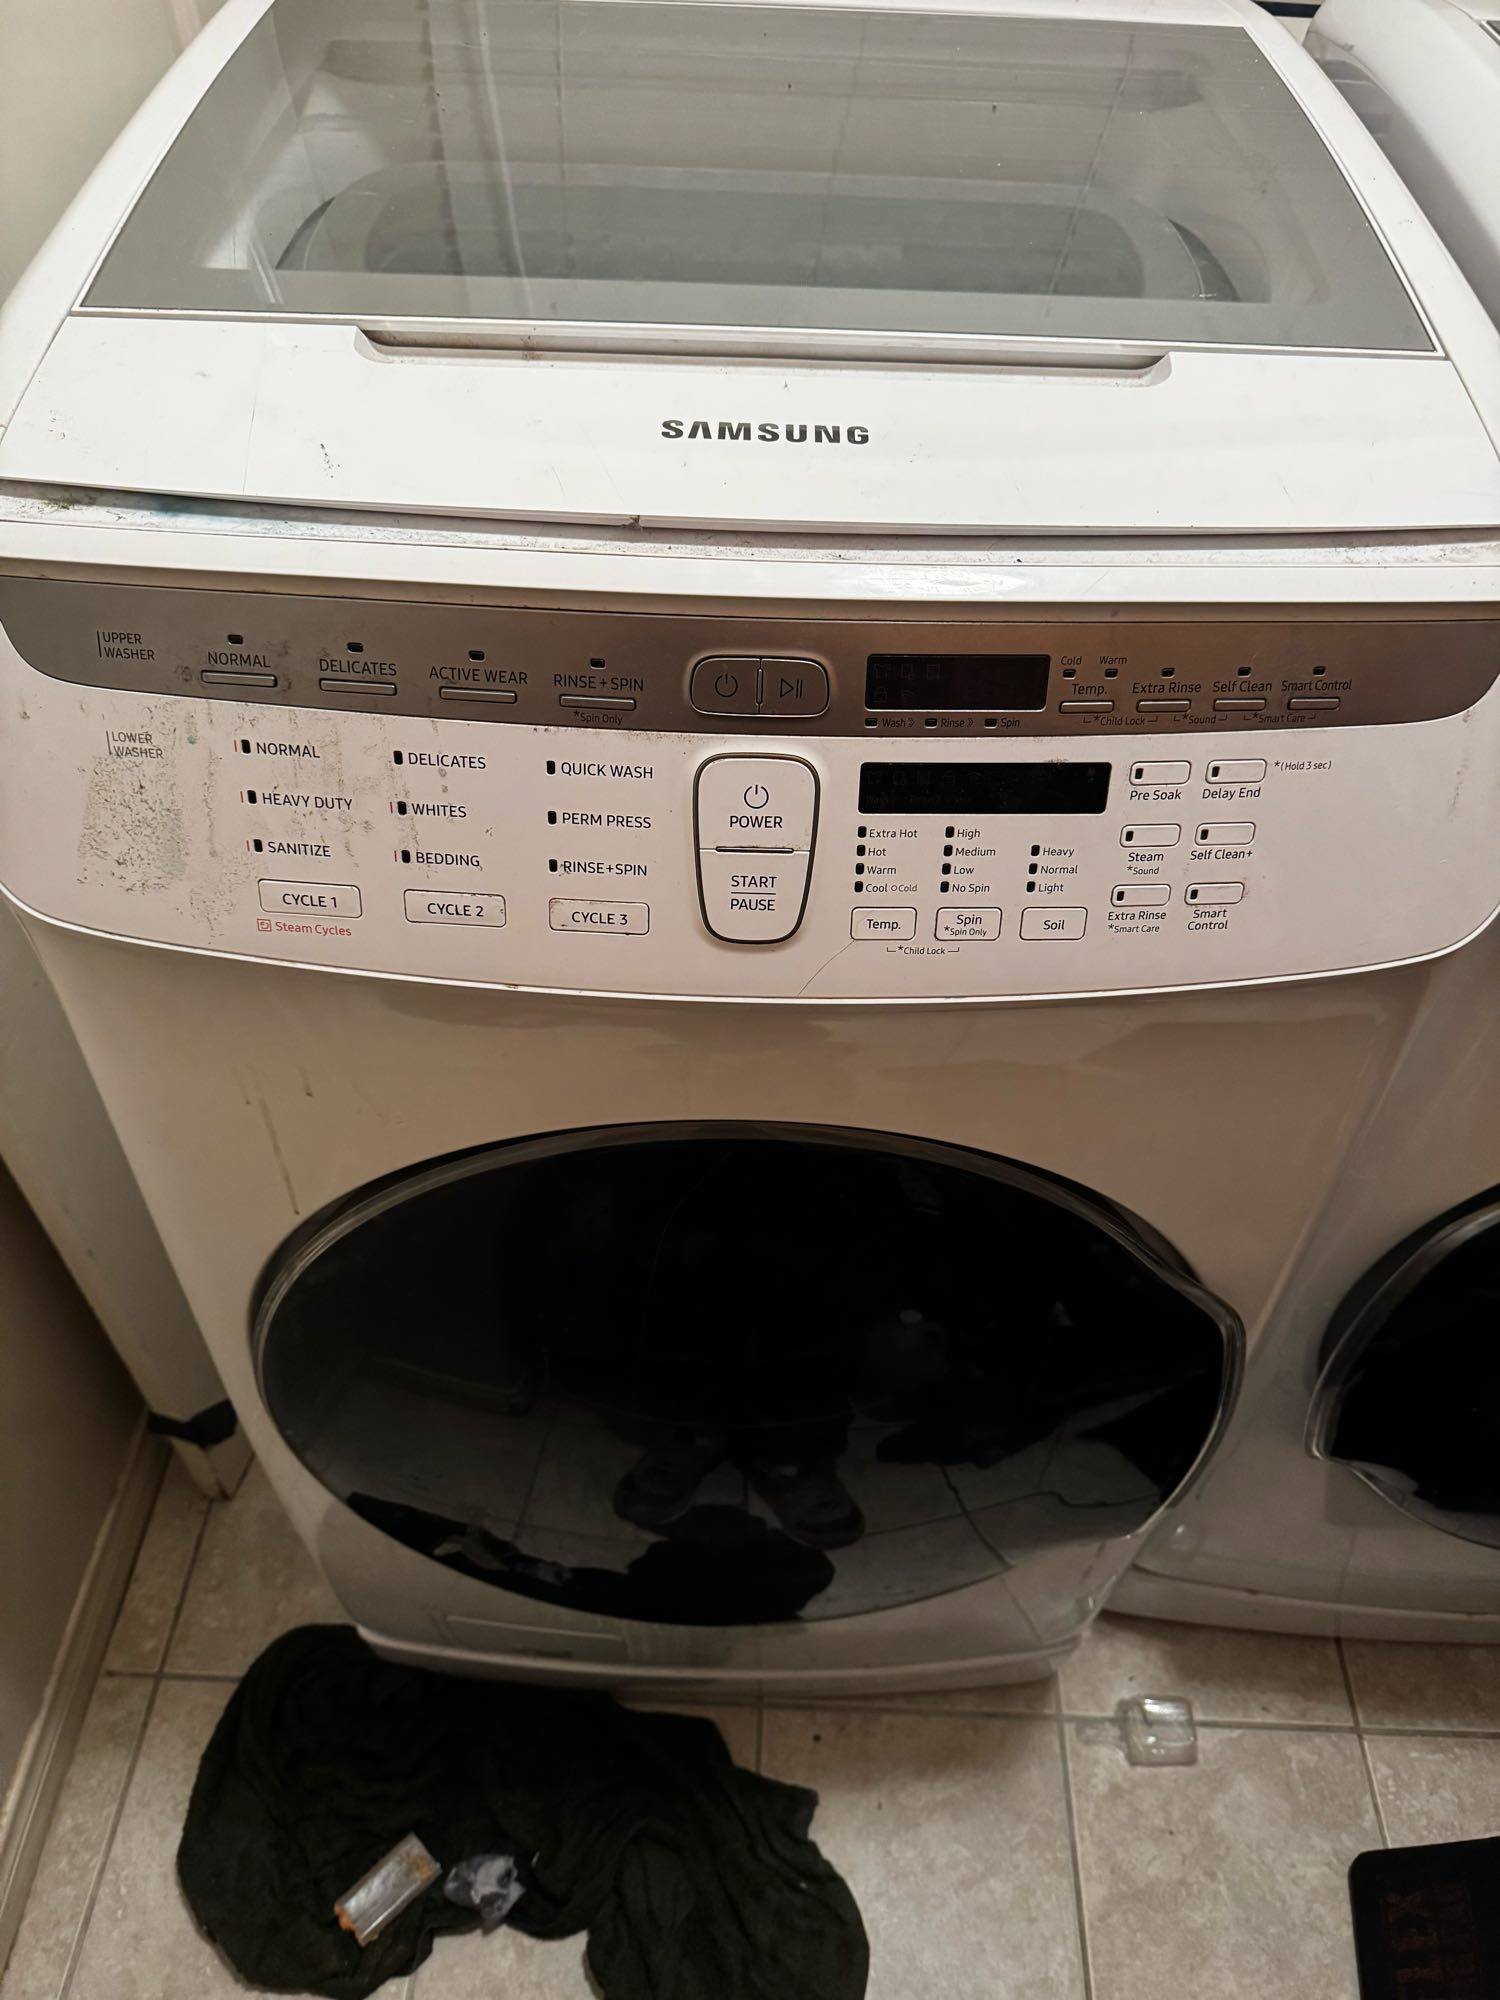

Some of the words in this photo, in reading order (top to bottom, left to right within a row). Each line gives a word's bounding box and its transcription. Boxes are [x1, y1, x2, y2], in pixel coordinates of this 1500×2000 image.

[661, 420, 870, 445] SAMSUNG
[102, 631, 142, 645] UPPER
[104, 647, 155, 661] WASHER
[208, 651, 271, 668] NORMAL
[1060, 656, 1082, 665] Cold
[1100, 656, 1127, 665] Warm
[319, 659, 397, 676] DELICATES
[429, 666, 481, 682] ACTIVE
[484, 669, 528, 685] WEAR
[1072, 683, 1108, 696] Temp.
[1132, 682, 1166, 694] Extra
[1169, 682, 1201, 693] Rinse
[1213, 682, 1244, 693] Self
[1246, 681, 1272, 692] Clean
[1282, 681, 1313, 692] Smart
[1315, 680, 1352, 691] Control
[602, 714, 623, 726] Only
[882, 718, 906, 728] Wash
[941, 718, 965, 728] Rinse
[1001, 718, 1020, 729] Spin
[1125, 716, 1145, 726] Lock
[1286, 714, 1306, 723] Care
[112, 731, 153, 745] LOWER
[113, 745, 163, 760] WASHER
[256, 742, 320, 759] NORMAL
[408, 753, 486, 770] DELICATES
[1307, 761, 1312, 770] 3
[1312, 760, 1332, 770] sec)
[561, 763, 607, 777] QUICK
[610, 765, 653, 779] WASH
[1130, 790, 1151, 801] Pre
[1153, 788, 1182, 800] Soak
[1202, 788, 1236, 801] Delay
[1238, 787, 1261, 798] End
[262, 793, 310, 808] HEAVY
[315, 796, 353, 811] DUTY
[412, 803, 467, 818] WHITES
[562, 813, 602, 826] PERM
[607, 815, 652, 829] PRESS
[730, 815, 783, 829] POWER
[869, 829, 897, 838] Extra
[899, 829, 918, 838] Hot
[957, 828, 981, 839] High
[268, 841, 331, 858] SANITIZE
[868, 847, 887, 856] Hot
[955, 847, 996, 857] Medium
[1042, 847, 1075, 858] Heavy
[1191, 850, 1213, 860] Self
[1215, 850, 1253, 859] Clean+
[416, 852, 480, 867] BEDDING
[1128, 852, 1164, 862] Steam
[562, 861, 648, 876] RINSE+SPIN
[867, 866, 897, 875] Warm
[954, 866, 975, 875] Low
[1040, 865, 1078, 874] Normal
[731, 875, 778, 888] START
[866, 883, 888, 893] Cool
[899, 884, 918, 892] Cold
[952, 884, 967, 892] No
[969, 883, 990, 894] Spin
[1038, 883, 1064, 894] Light
[282, 893, 327, 908] CYCLE
[330, 896, 338, 908] 1
[731, 898, 776, 911] PAUSE
[427, 902, 471, 917] CYCLE
[476, 905, 484, 917] 2
[1108, 912, 1136, 920] Extra
[1138, 911, 1167, 920] Rinse
[1193, 909, 1228, 919] Smart
[572, 911, 616, 925] CYCLE
[619, 914, 628, 926] 3
[867, 919, 901, 930] Temp.
[956, 914, 983, 926] Spin
[1043, 919, 1065, 930] Soil
[275, 921, 313, 934] Steam
[315, 924, 352, 937] Cycles
[1141, 925, 1160, 933] Care
[1187, 920, 1228, 931] Control
[969, 928, 987, 937] Only
[927, 947, 946, 955] Lock
